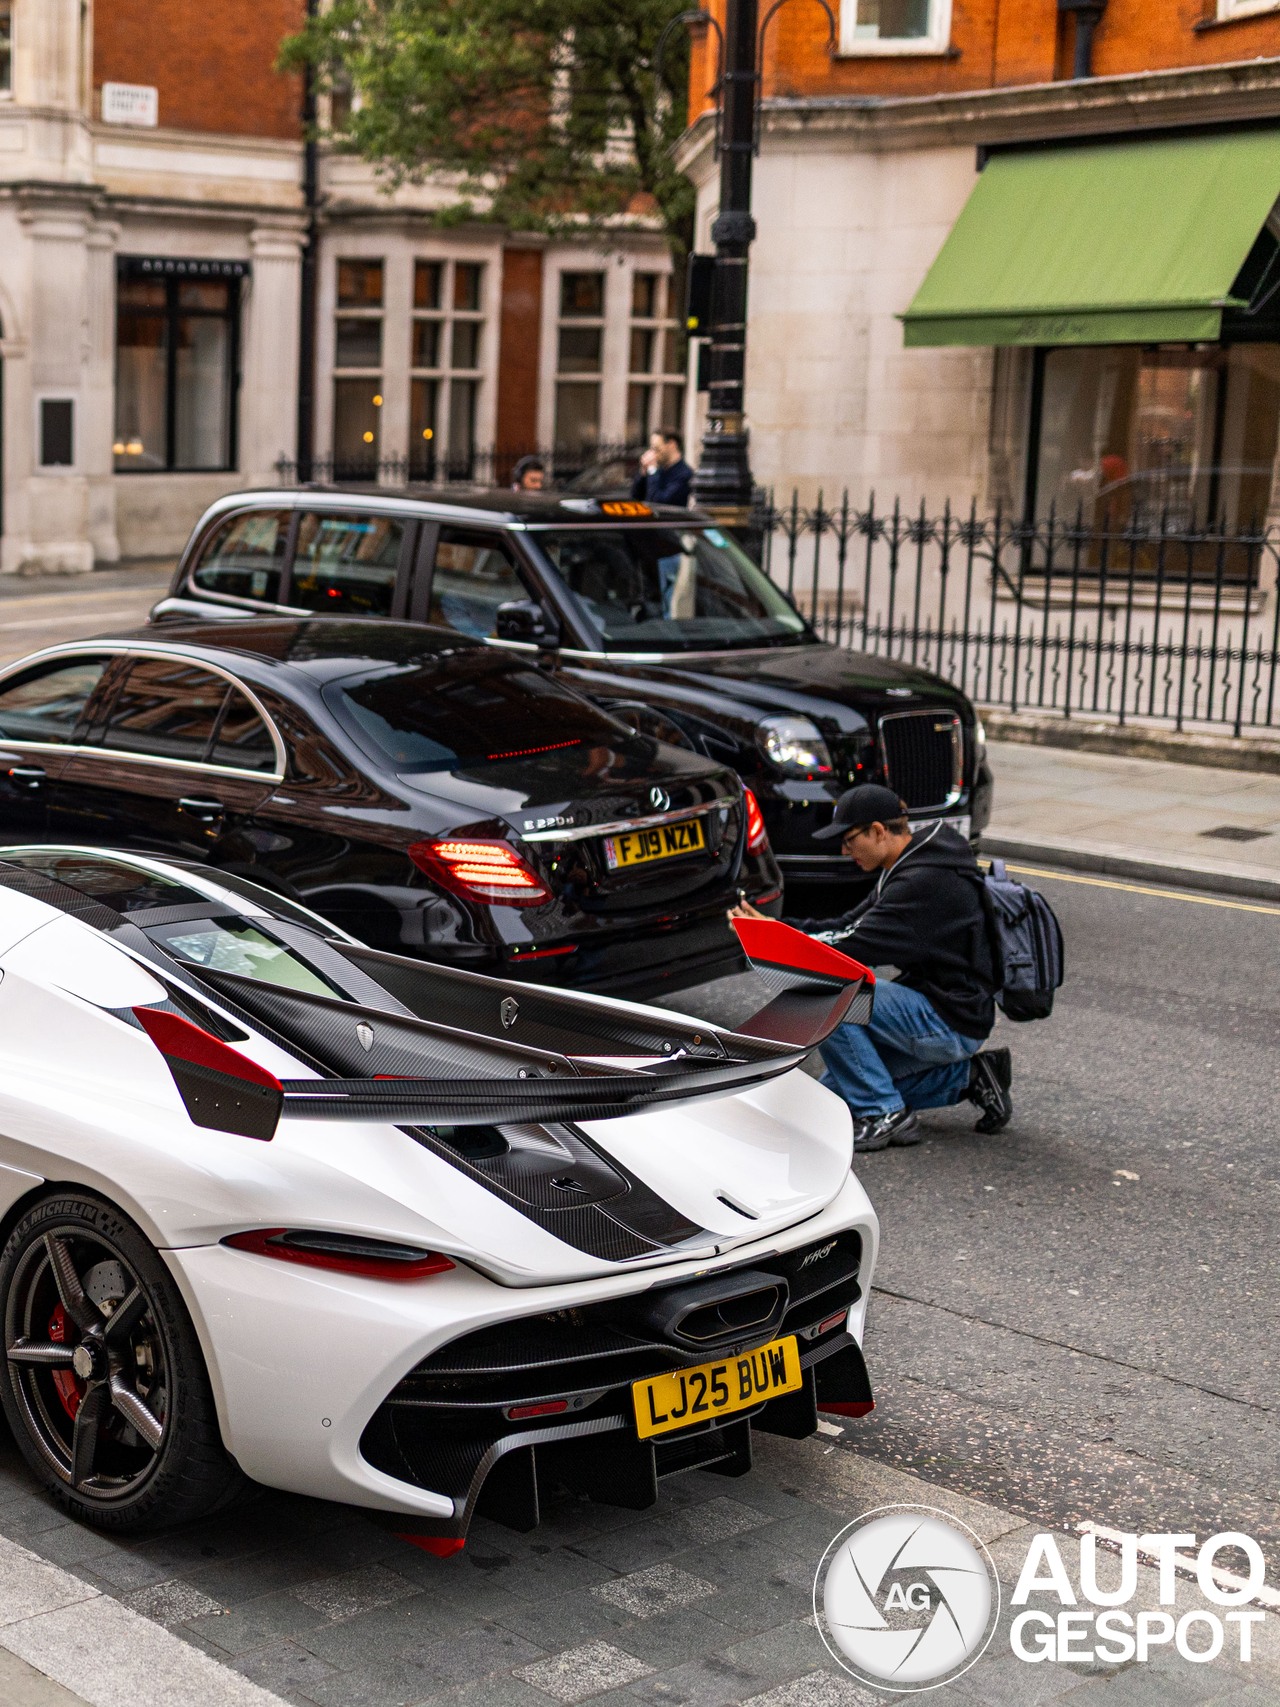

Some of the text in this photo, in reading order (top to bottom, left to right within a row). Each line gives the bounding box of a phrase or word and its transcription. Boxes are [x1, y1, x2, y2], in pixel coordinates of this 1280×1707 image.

[620, 822, 700, 862] FJ19 NZW
[30, 1200, 98, 1226] MICHELIN
[647, 1345, 787, 1426] LJ25 BUW
